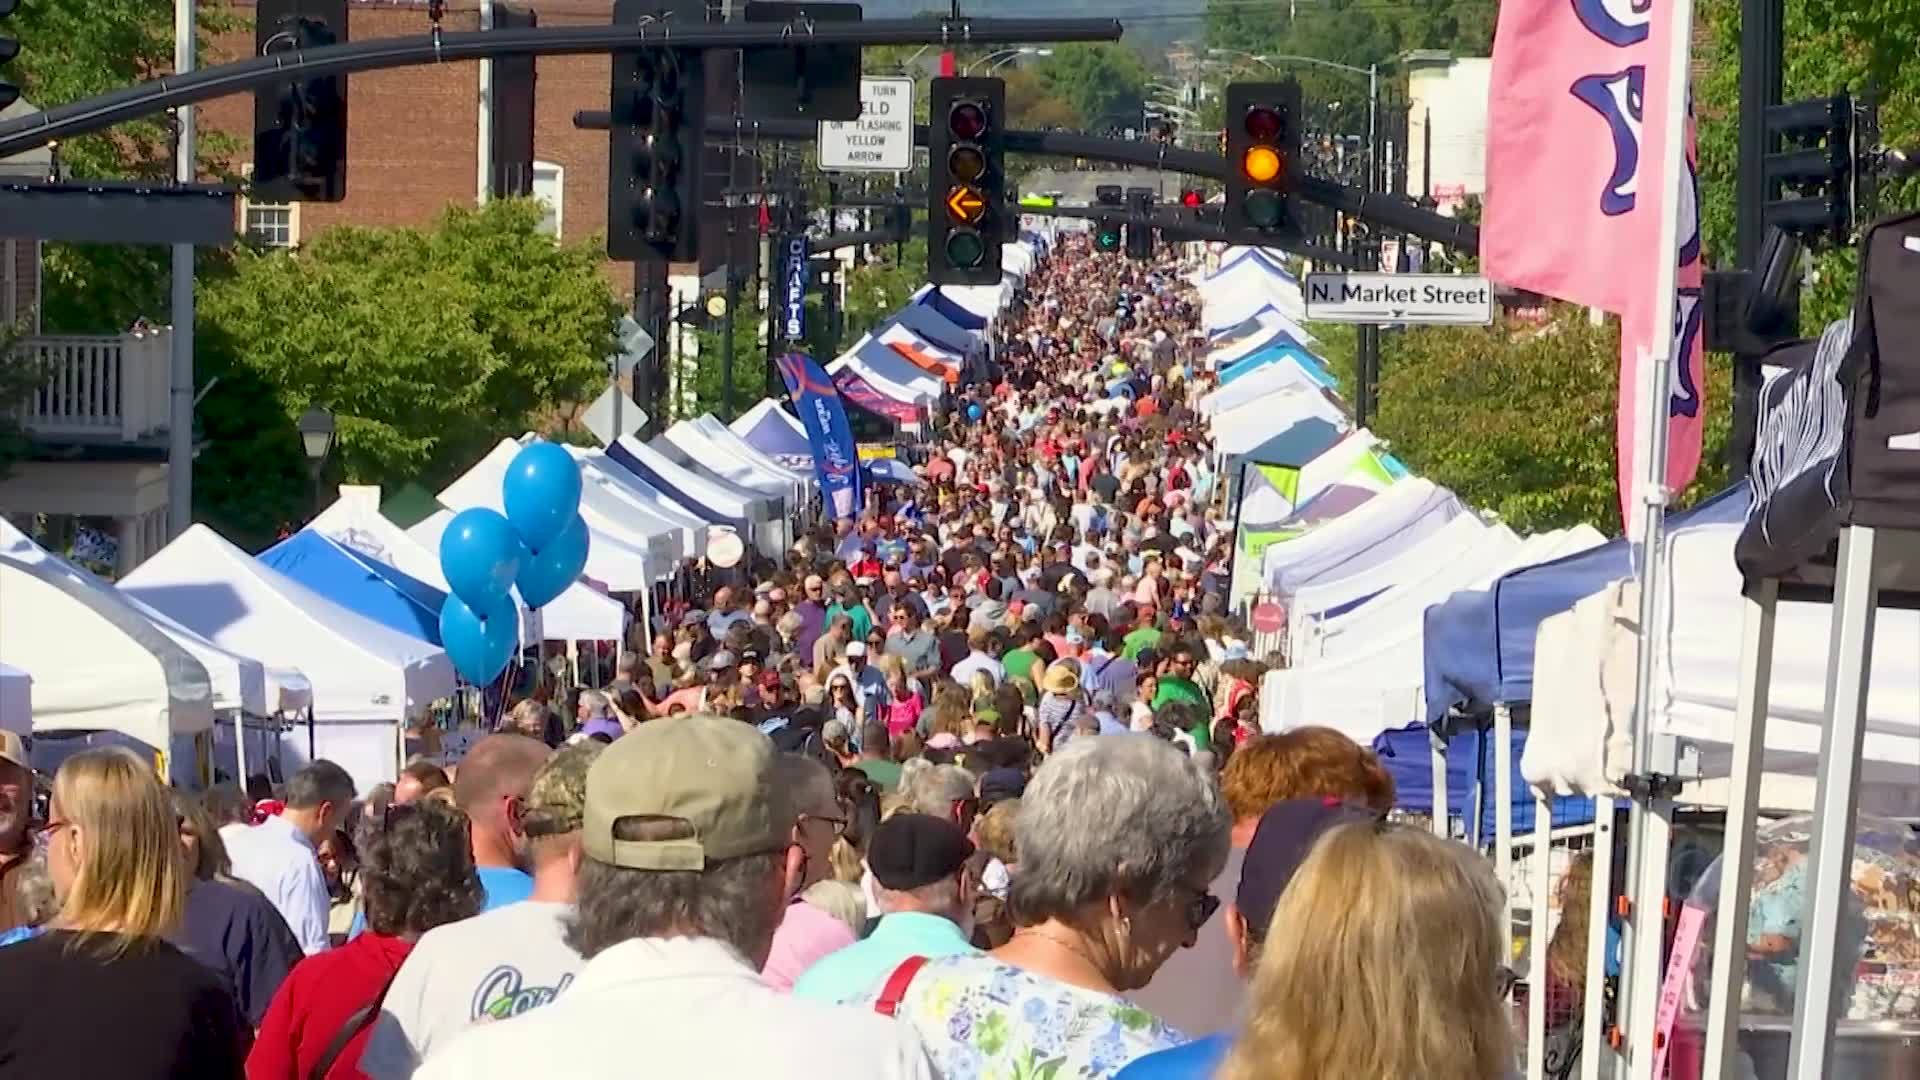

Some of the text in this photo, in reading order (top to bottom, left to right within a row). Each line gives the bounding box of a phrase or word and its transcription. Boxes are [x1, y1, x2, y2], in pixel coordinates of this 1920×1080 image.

[872, 86, 897, 96] TURN
[861, 101, 890, 115] ELD
[830, 120, 902, 132] ON FLASHING
[846, 136, 886, 146] YELLOW
[847, 151, 883, 161] ARROW
[787, 239, 802, 335] CRAFTS
[1312, 283, 1488, 304] N. Market Street
